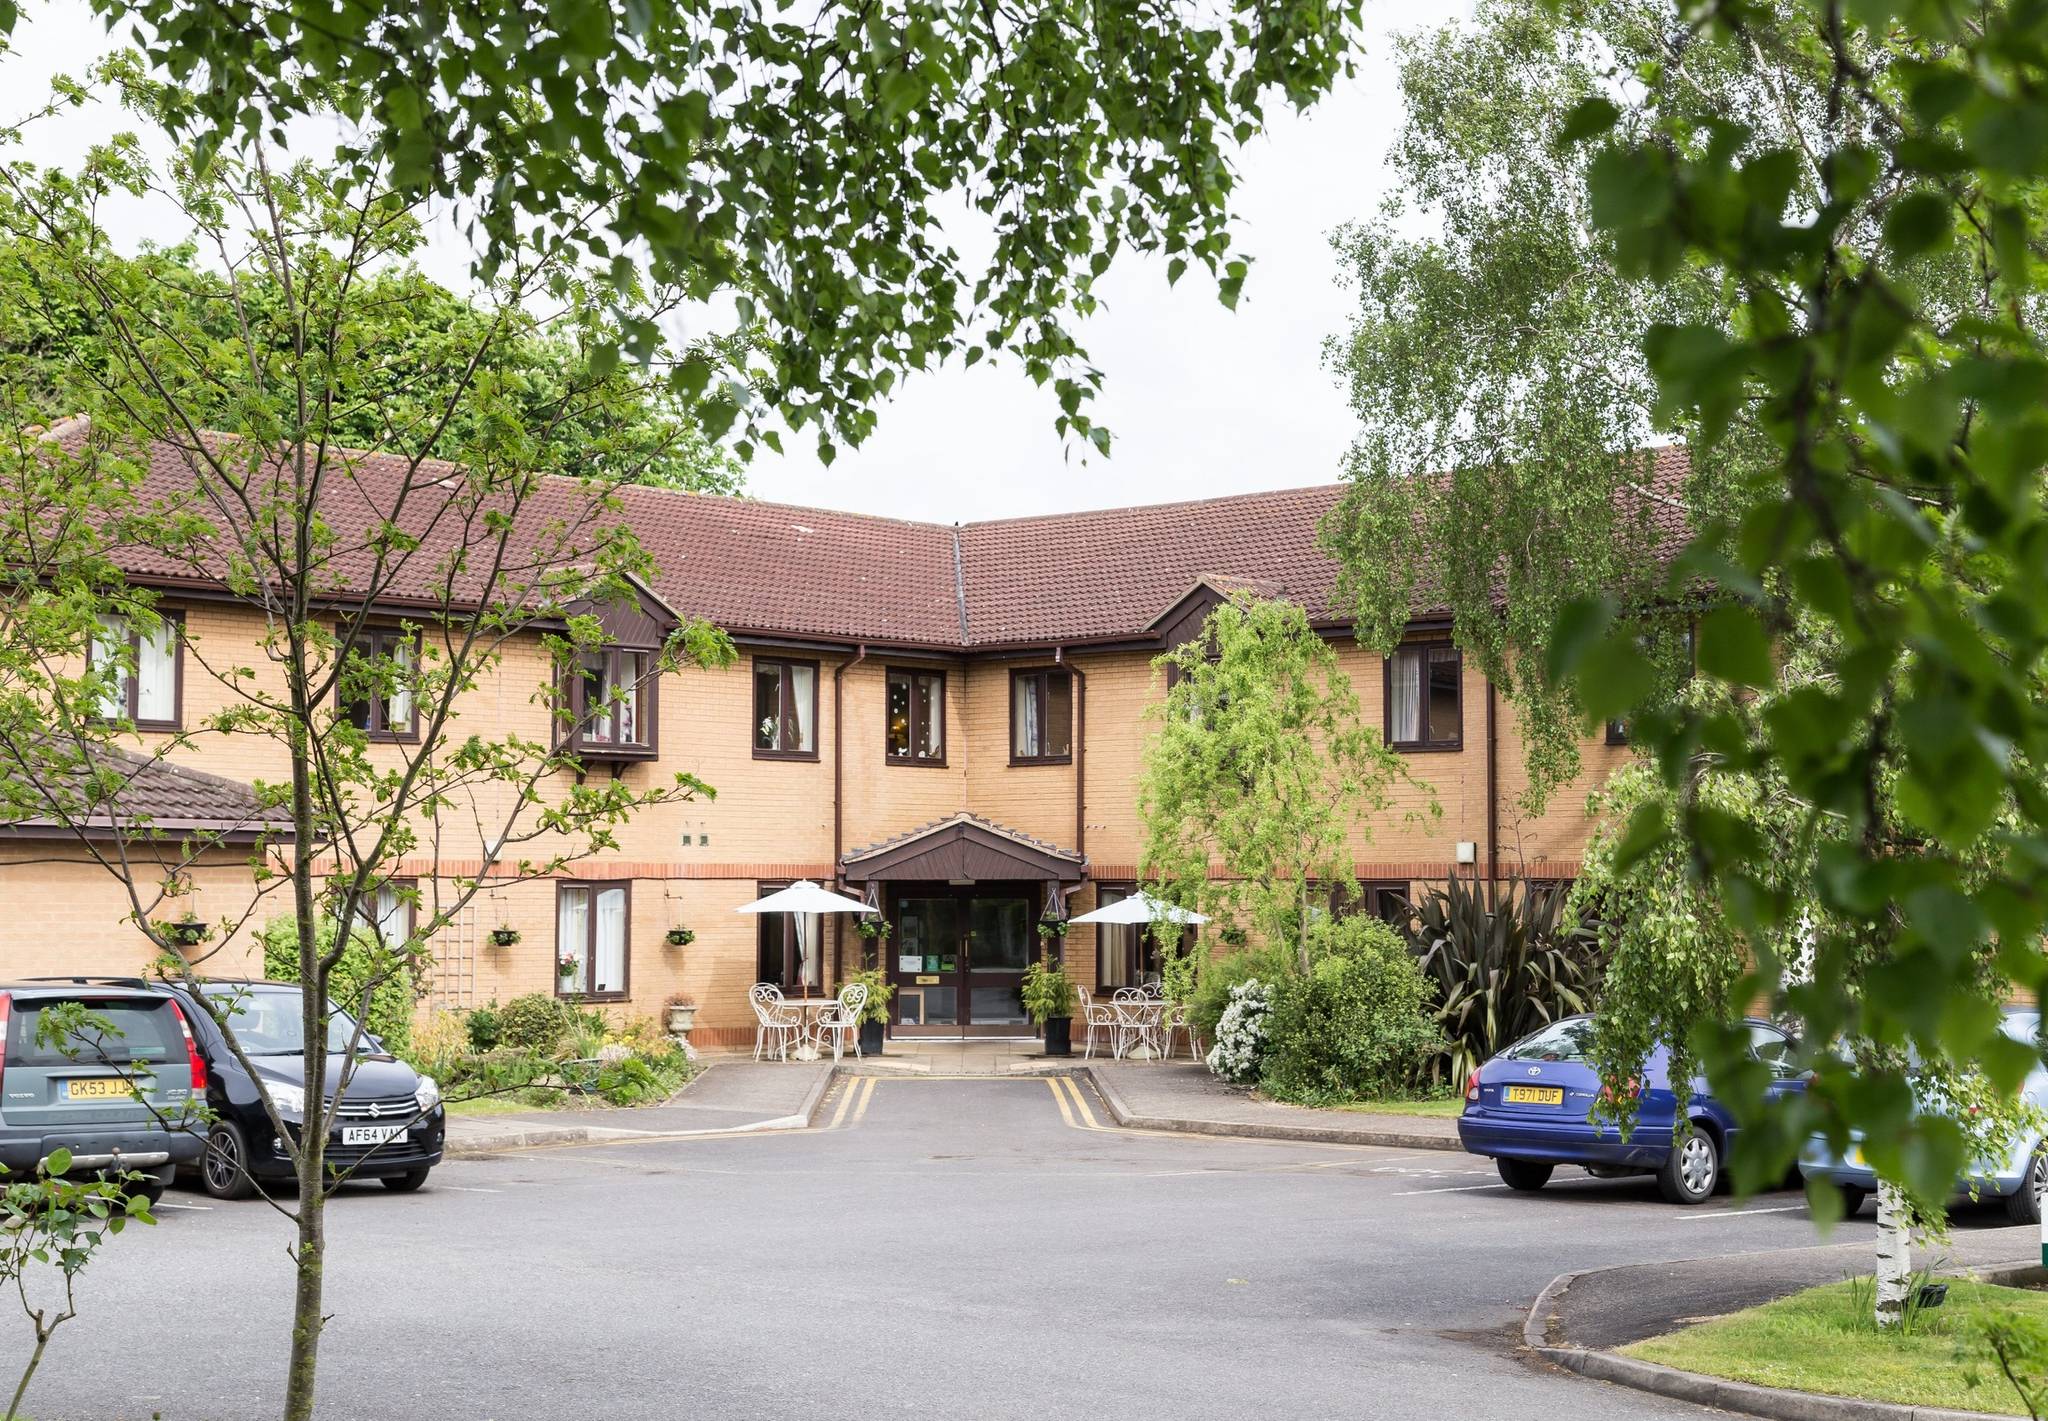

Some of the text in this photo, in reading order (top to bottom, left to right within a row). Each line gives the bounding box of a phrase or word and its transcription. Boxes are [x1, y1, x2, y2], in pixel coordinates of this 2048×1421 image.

[70, 1081, 106, 1096] GK53
[1512, 1088, 1559, 1102] T971 DUF
[349, 1129, 378, 1141] AF64
